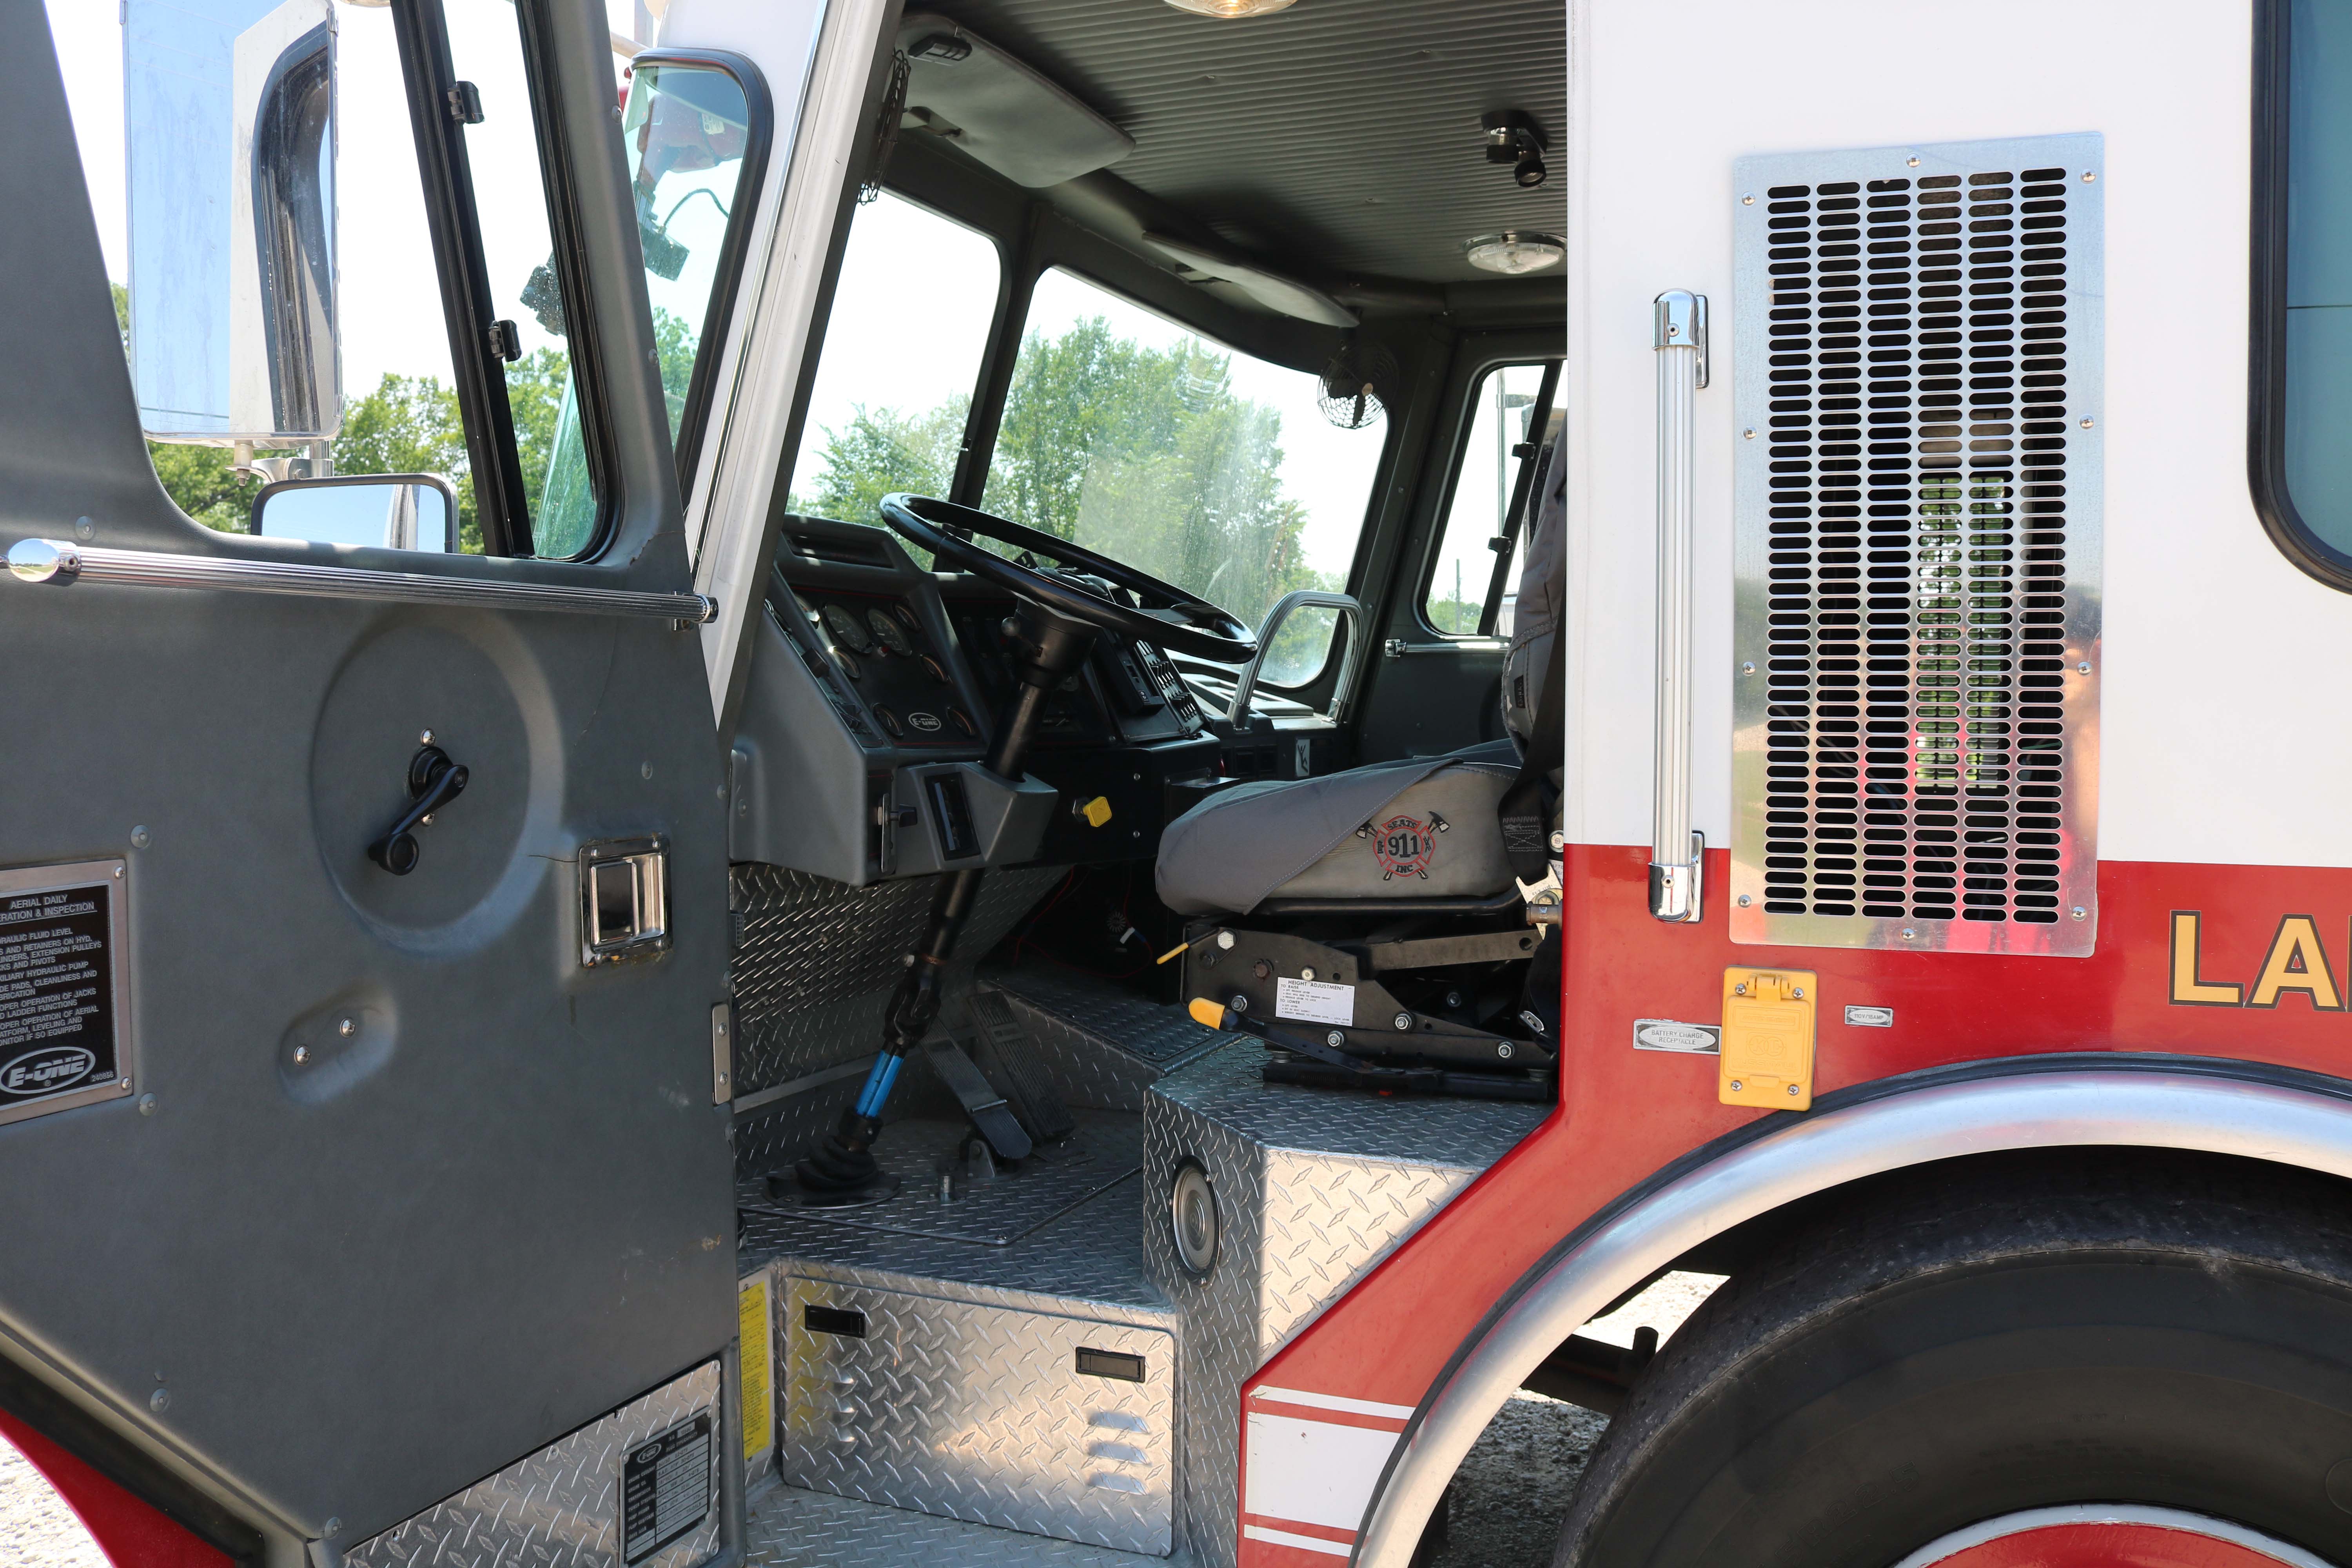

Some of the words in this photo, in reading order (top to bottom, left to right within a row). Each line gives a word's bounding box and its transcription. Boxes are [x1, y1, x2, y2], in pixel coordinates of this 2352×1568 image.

[1387, 819, 1417, 829] SEATS
[1388, 833, 1420, 858] 911
[1396, 865, 1413, 873] INC
[10, 898, 41, 909] AERIAL
[45, 895, 68, 905] DAILY
[36, 909, 41, 917] &
[45, 902, 94, 916] INSPECTION
[30, 931, 50, 940] FLUID
[52, 928, 73, 937] LEVEL
[6, 946, 21, 955] AND
[24, 940, 61, 951] RETAINERS
[32, 946, 70, 958] EXTENSION
[73, 941, 102, 951] PULLEYS
[13, 960, 28, 969] AND
[31, 956, 56, 966] PIVOTS
[2168, 910, 2352, 1012] LA
[27, 964, 66, 977] HYDRAULIC
[69, 961, 89, 970] PUMP
[12, 981, 32, 991] PADS,
[34, 973, 81, 986] CLEANLINESS
[21, 995, 60, 1007] OPERATION
[74, 988, 96, 998] JACKS
[7, 1007, 36, 1018] LADDER
[39, 1000, 77, 1012] FUNCTIONS
[22, 1013, 61, 1025] OPERATION
[75, 1006, 99, 1015] AERIAL
[33, 1020, 66, 1031] LEVELING
[67, 1016, 82, 1025] AND
[48, 1024, 82, 1036] EQUIPPED
[1659, 1036, 1696, 1045] RECEPTACLE
[8, 1054, 86, 1087] E-ONE
[92, 1071, 114, 1082] 240856
